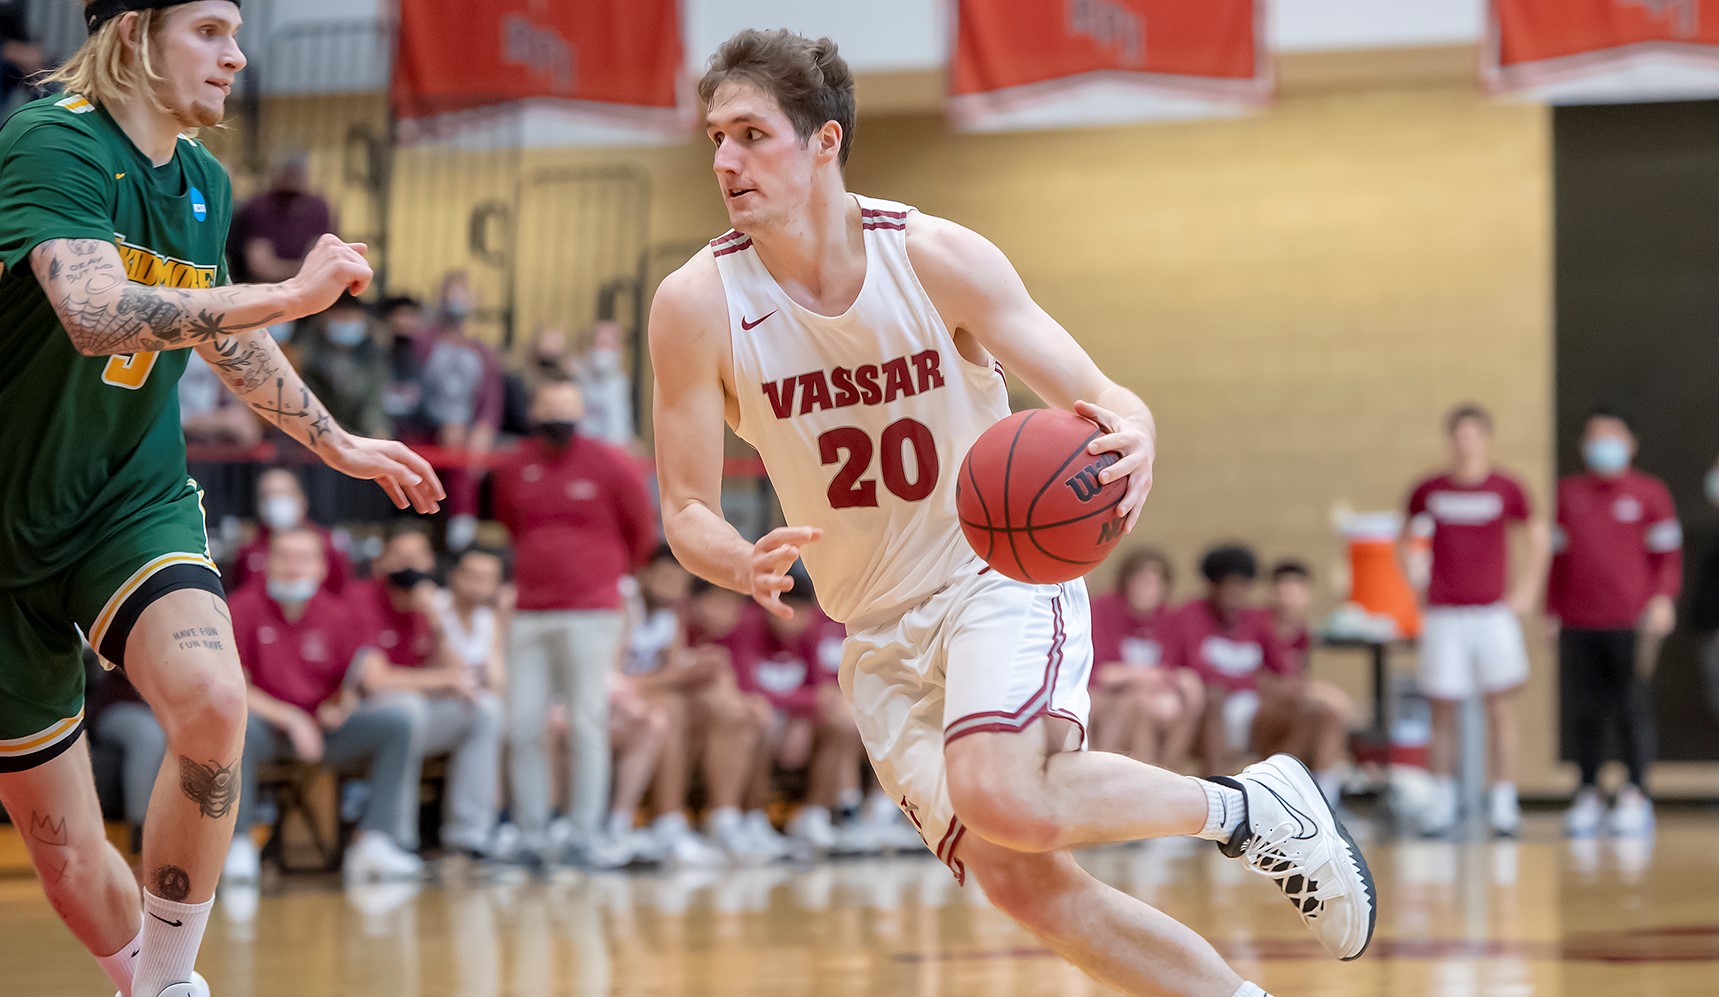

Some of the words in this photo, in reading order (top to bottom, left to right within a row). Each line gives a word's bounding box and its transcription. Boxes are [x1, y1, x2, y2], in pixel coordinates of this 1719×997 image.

[113, 232, 217, 288] KIDMORE
[762, 348, 946, 420] VASSAR
[817, 416, 940, 510] 20
[172, 628, 197, 641] HAVE
[199, 627, 219, 637] FUN
[179, 640, 201, 651] FUN
